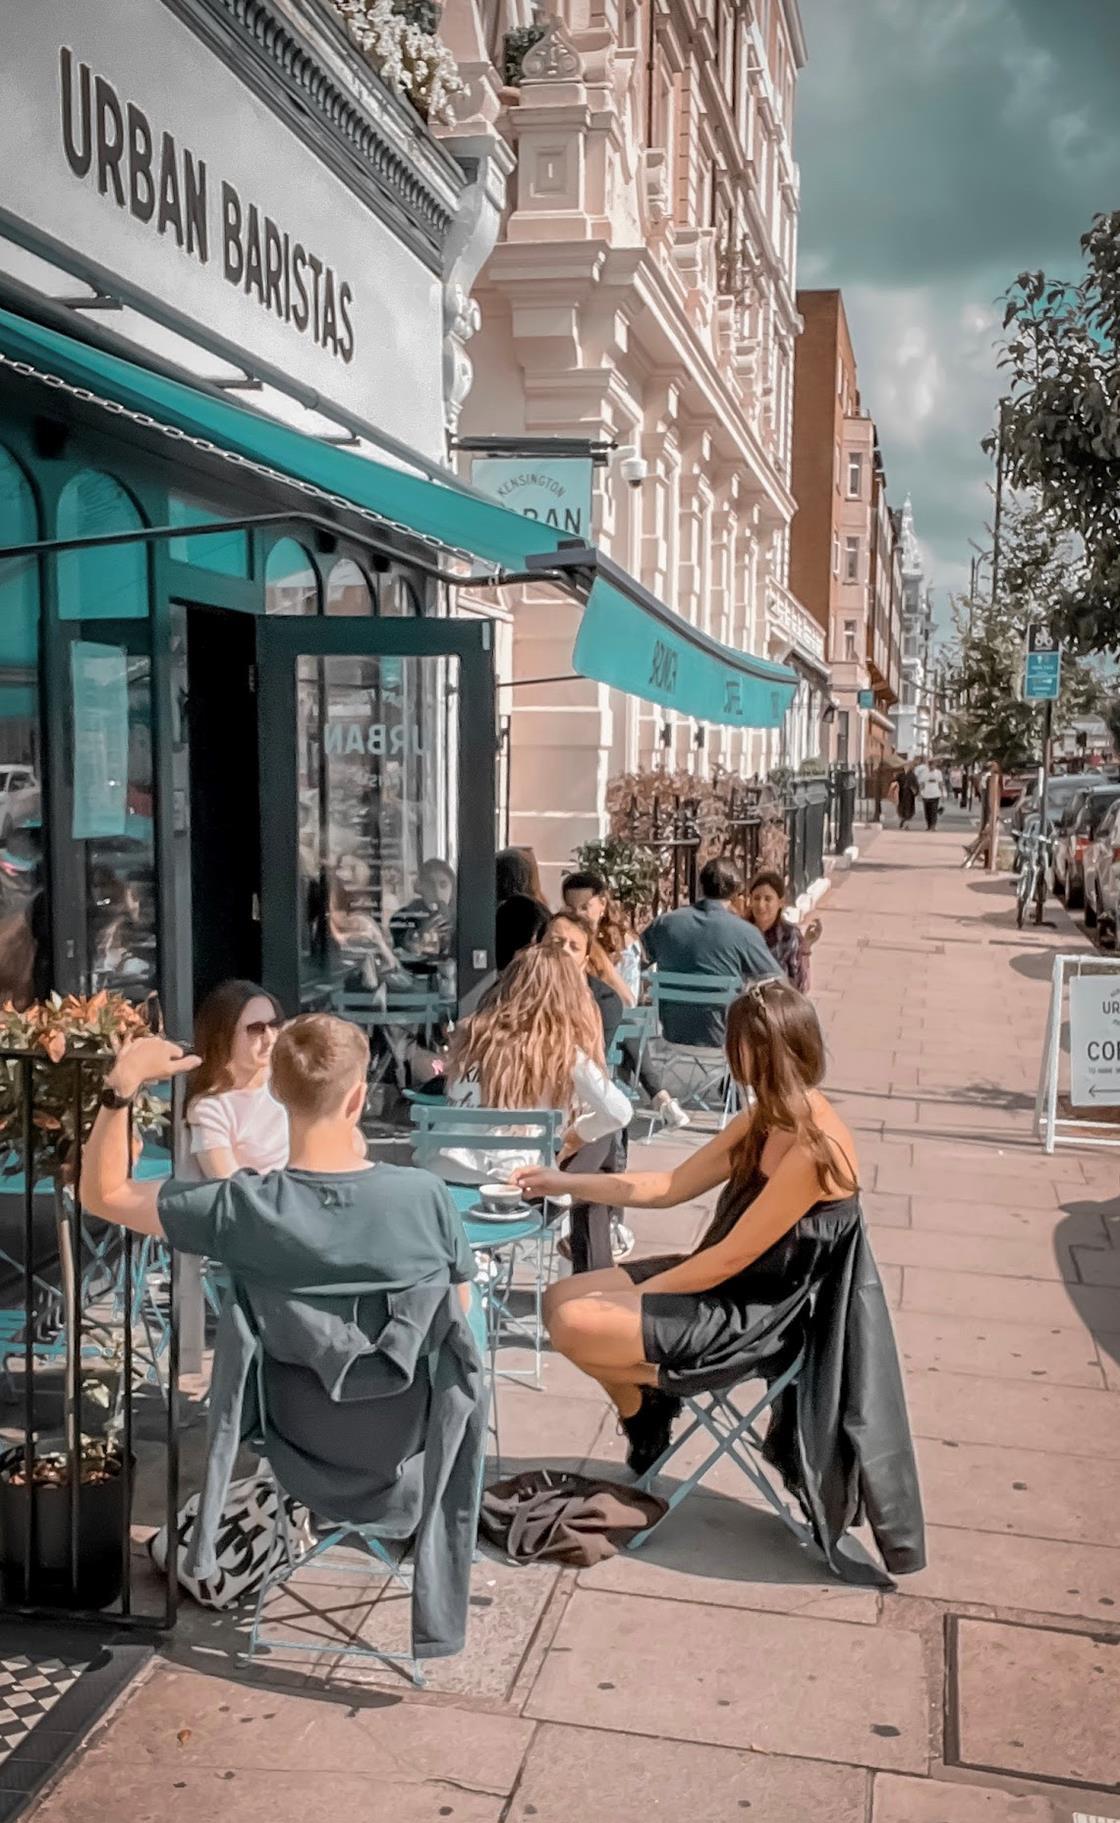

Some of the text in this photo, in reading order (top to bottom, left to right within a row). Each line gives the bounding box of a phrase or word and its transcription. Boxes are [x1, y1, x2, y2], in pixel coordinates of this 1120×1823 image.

[60, 46, 353, 364] URBAN BARISTAS
[497, 473, 567, 498] KENSINGTON
